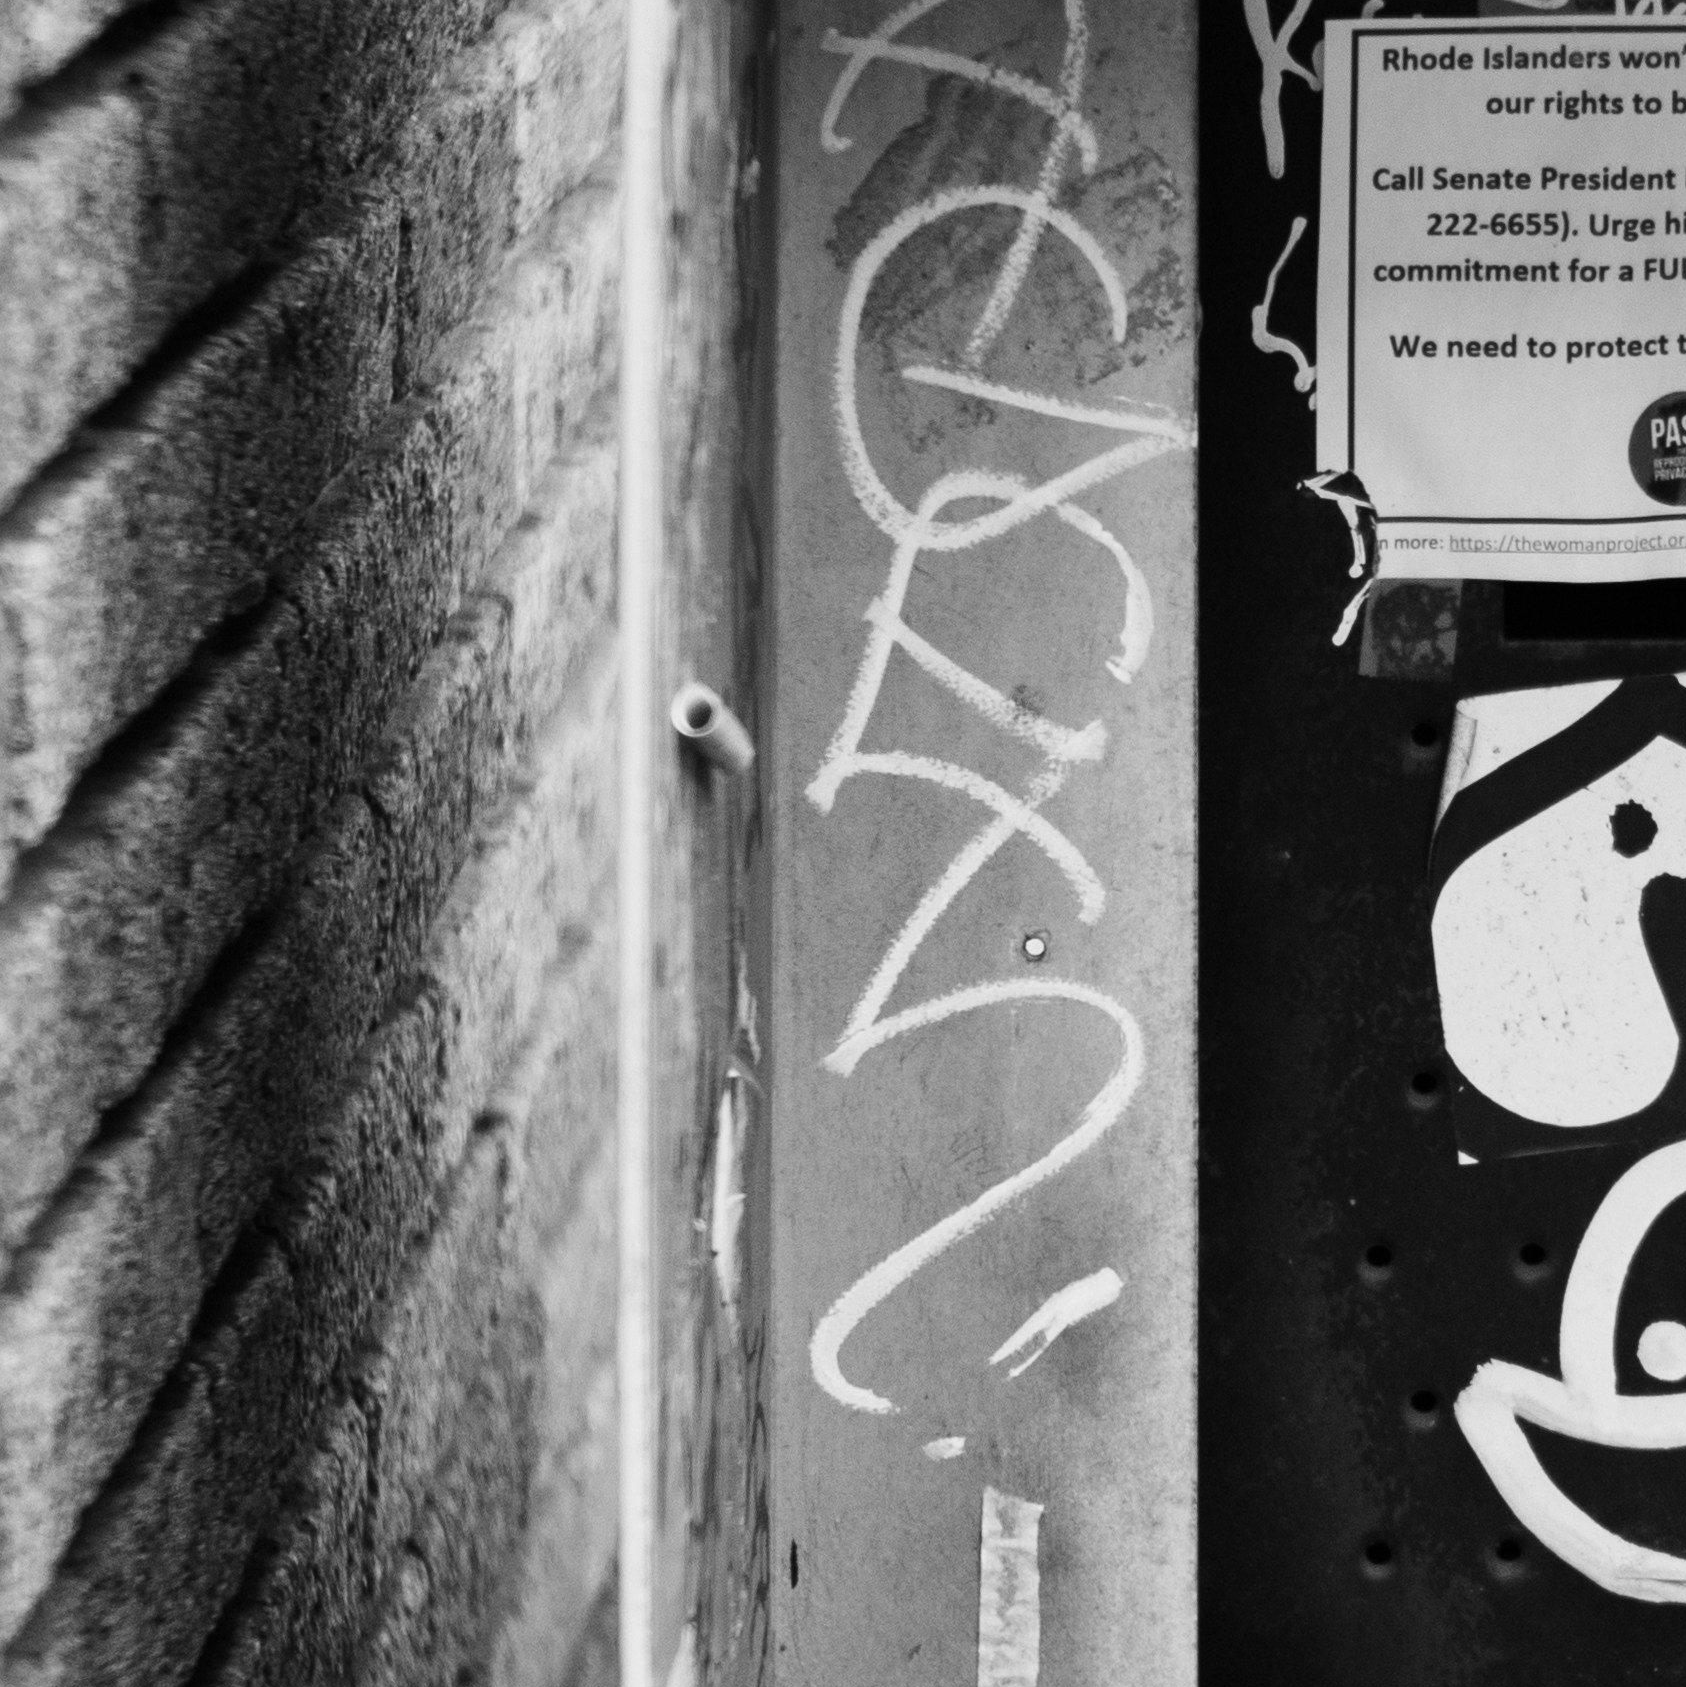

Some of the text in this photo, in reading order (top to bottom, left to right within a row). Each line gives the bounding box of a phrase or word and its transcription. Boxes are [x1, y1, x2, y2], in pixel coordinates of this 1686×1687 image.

[1382, 45, 1474, 72] Rhode
[1483, 44, 1612, 71] Islanders
[1485, 96, 1536, 115] our
[1543, 89, 1625, 121] rights
[1631, 93, 1663, 115] to
[1372, 165, 1424, 192] Call
[1432, 166, 1532, 191] Senate
[1540, 165, 1677, 191] President
[1426, 210, 1579, 243] 222-6655).
[1588, 213, 1656, 243] Urge
[1372, 257, 1561, 283] commitment
[1567, 257, 1611, 283] for
[1617, 264, 1635, 283] a
[1388, 334, 1438, 359] We
[1446, 333, 1518, 359] need
[1525, 336, 1557, 359] to
[1566, 334, 1670, 365] protect
[1394, 535, 1444, 552] more:
